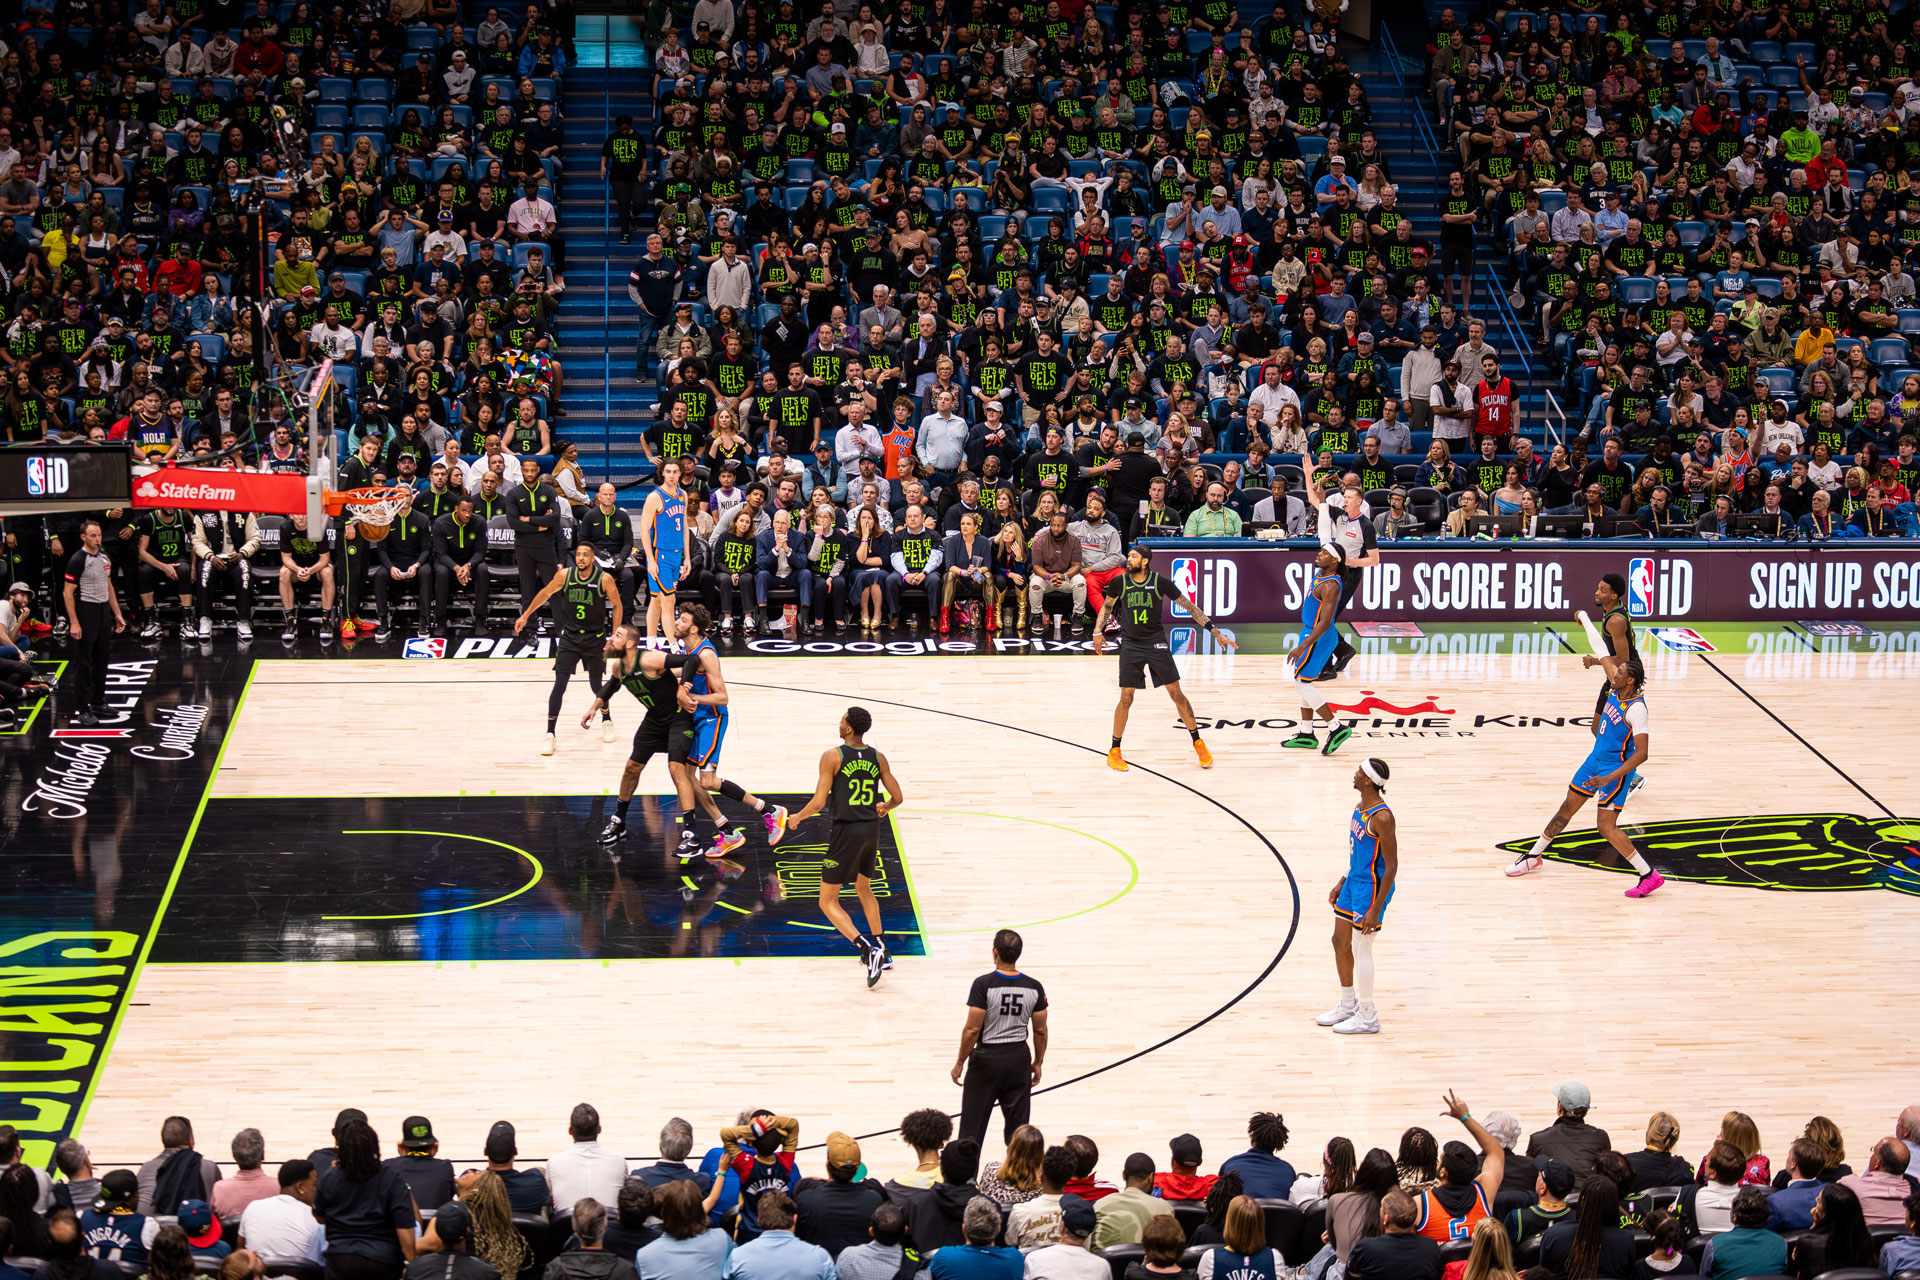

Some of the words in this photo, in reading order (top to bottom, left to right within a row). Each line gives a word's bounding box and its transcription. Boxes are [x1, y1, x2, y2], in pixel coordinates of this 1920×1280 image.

[1791, 139, 1812, 150] NOLA
[1489, 158, 1502, 166] LET'S
[1610, 168, 1632, 179] PELS
[1510, 192, 1524, 200] LET'S
[1802, 197, 1809, 205] GO
[1600, 199, 1605, 209] 3
[1621, 248, 1633, 256] LET'S
[997, 271, 1011, 279] LET'S
[1192, 299, 1206, 307] LET'S
[1117, 307, 1125, 315] GO
[59, 330, 74, 338] LET'S
[77, 330, 85, 338] GO
[1164, 330, 1172, 338] GO
[60, 338, 85, 350] PELS
[813, 356, 828, 365] LET'S
[831, 357, 840, 365] GO
[720, 365, 733, 374] LET'S
[813, 365, 840, 381] PELS
[980, 367, 996, 376] LET'S
[998, 367, 1006, 375] GO
[1030, 363, 1045, 372] LET'S
[1048, 362, 1056, 371] GO
[1165, 363, 1179, 372] LET'S
[720, 374, 744, 388] PELS
[981, 375, 1006, 390] PELS
[1030, 371, 1056, 386] PELS
[679, 393, 693, 402] LET'S
[698, 393, 707, 402] GO
[781, 397, 796, 407] LET'S
[800, 397, 809, 406] GO
[1481, 394, 1508, 406] PELICANS
[687, 402, 706, 417] ELS
[1357, 400, 1372, 409] LET'S
[782, 406, 808, 422] PELS
[1488, 407, 1499, 422] 14
[143, 433, 165, 444] NOLA
[516, 429, 536, 441] NOLA
[664, 432, 679, 442] LET'S
[683, 433, 692, 442] GO
[893, 434, 912, 447] OKC
[1322, 432, 1338, 440] LET'S
[1778, 433, 1795, 441] ORLEANS
[522, 441, 530, 451] 5
[1323, 439, 1348, 451] PELS
[899, 447, 905, 457] 7
[1038, 464, 1055, 473] LET'S
[1059, 464, 1068, 473] GO
[1378, 470, 1385, 479] GO
[1494, 466, 1503, 475] GO
[47, 458, 69, 493] iD
[1598, 475, 1612, 485] LET'S
[1615, 476, 1624, 484] GO
[666, 505, 685, 517] THUNDE
[675, 517, 681, 530] 3
[158, 531, 180, 543] NOLA
[724, 541, 742, 552] LET'S
[902, 538, 920, 550] LET'S
[923, 539, 931, 549] GO
[162, 544, 178, 557] 22
[903, 550, 931, 562] PELS
[724, 552, 752, 569] PELS
[1203, 559, 1238, 616] iD
[1362, 563, 1404, 610] UP.
[1412, 562, 1507, 610] SCORE
[1515, 562, 1570, 610] BIG.
[1660, 559, 1693, 616] iD
[1750, 562, 1817, 609] SIGN
[1824, 562, 1865, 609] UP.
[568, 588, 593, 605] NOLA
[1127, 591, 1153, 608] NOLA
[576, 605, 586, 619] 3
[1631, 603, 1644, 613] NBA
[1133, 609, 1148, 624] 14
[746, 638, 976, 655] Google
[994, 638, 1122, 652] Pixe
[130, 704, 209, 761] Courtside
[1600, 719, 1607, 735] 8
[841, 760, 870, 777] MURPHY
[870, 764, 880, 777] III
[22, 741, 111, 819] Michelob
[848, 779, 874, 805] 25
[1000, 993, 1023, 1016] 55
[85, 1227, 132, 1248] INGRAM
